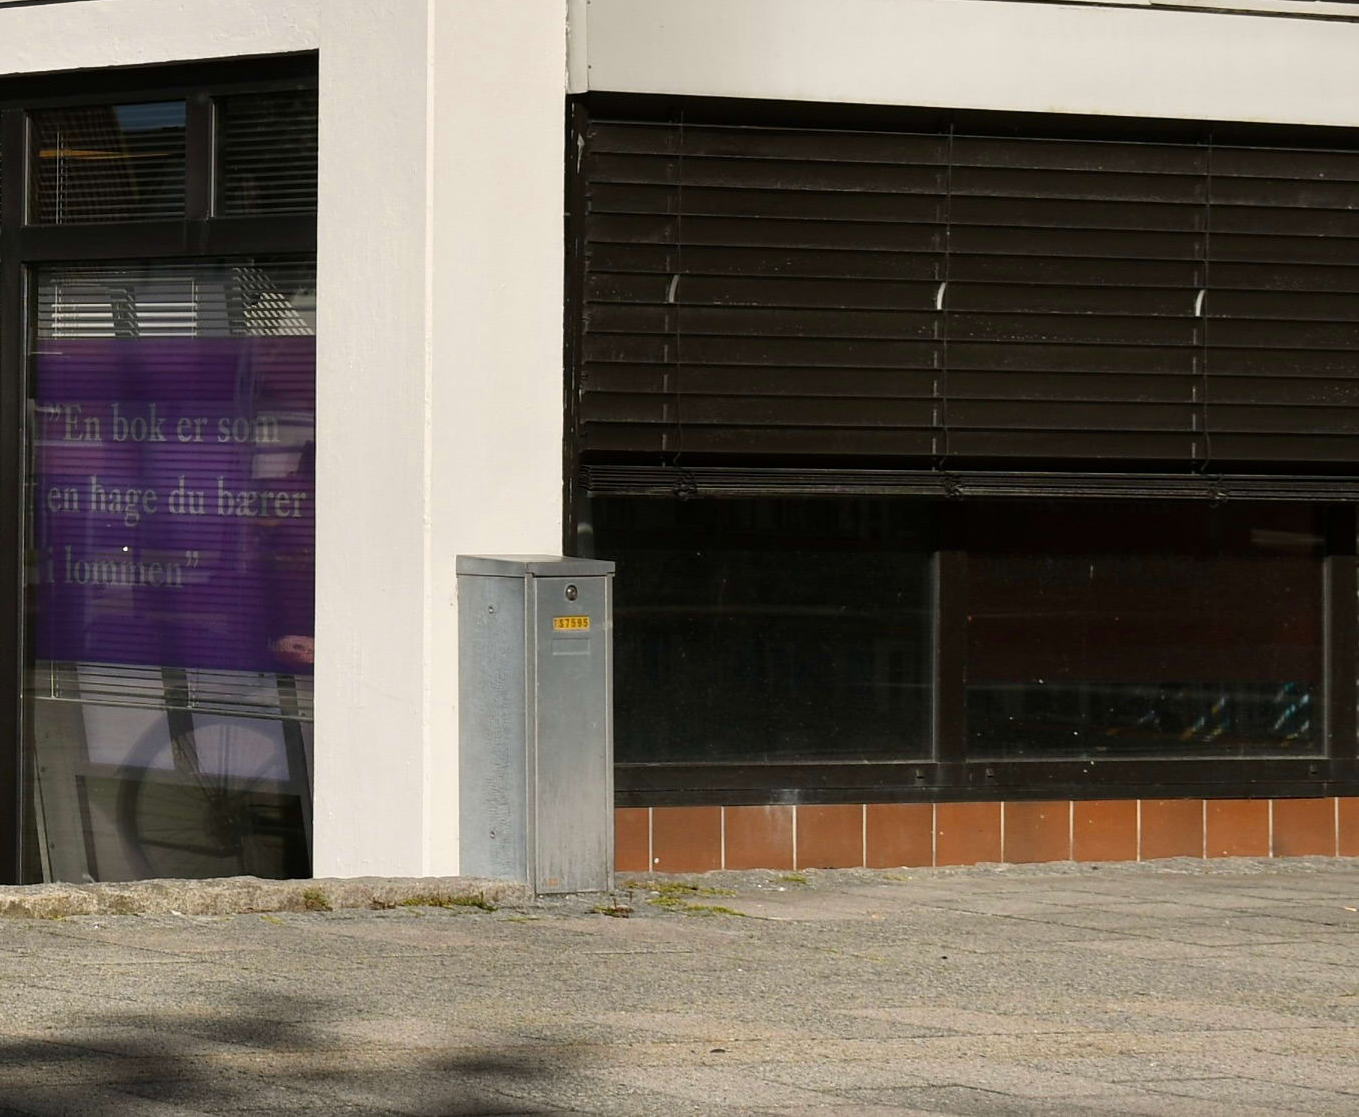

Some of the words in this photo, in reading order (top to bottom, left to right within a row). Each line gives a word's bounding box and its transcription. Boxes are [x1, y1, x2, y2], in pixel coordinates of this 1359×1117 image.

[111, 403, 167, 442] bok
[176, 415, 208, 443] er
[217, 415, 281, 443] som
[47, 485, 79, 514] en
[90, 474, 158, 527] hage
[168, 475, 207, 515] du
[217, 476, 307, 517] bærer
